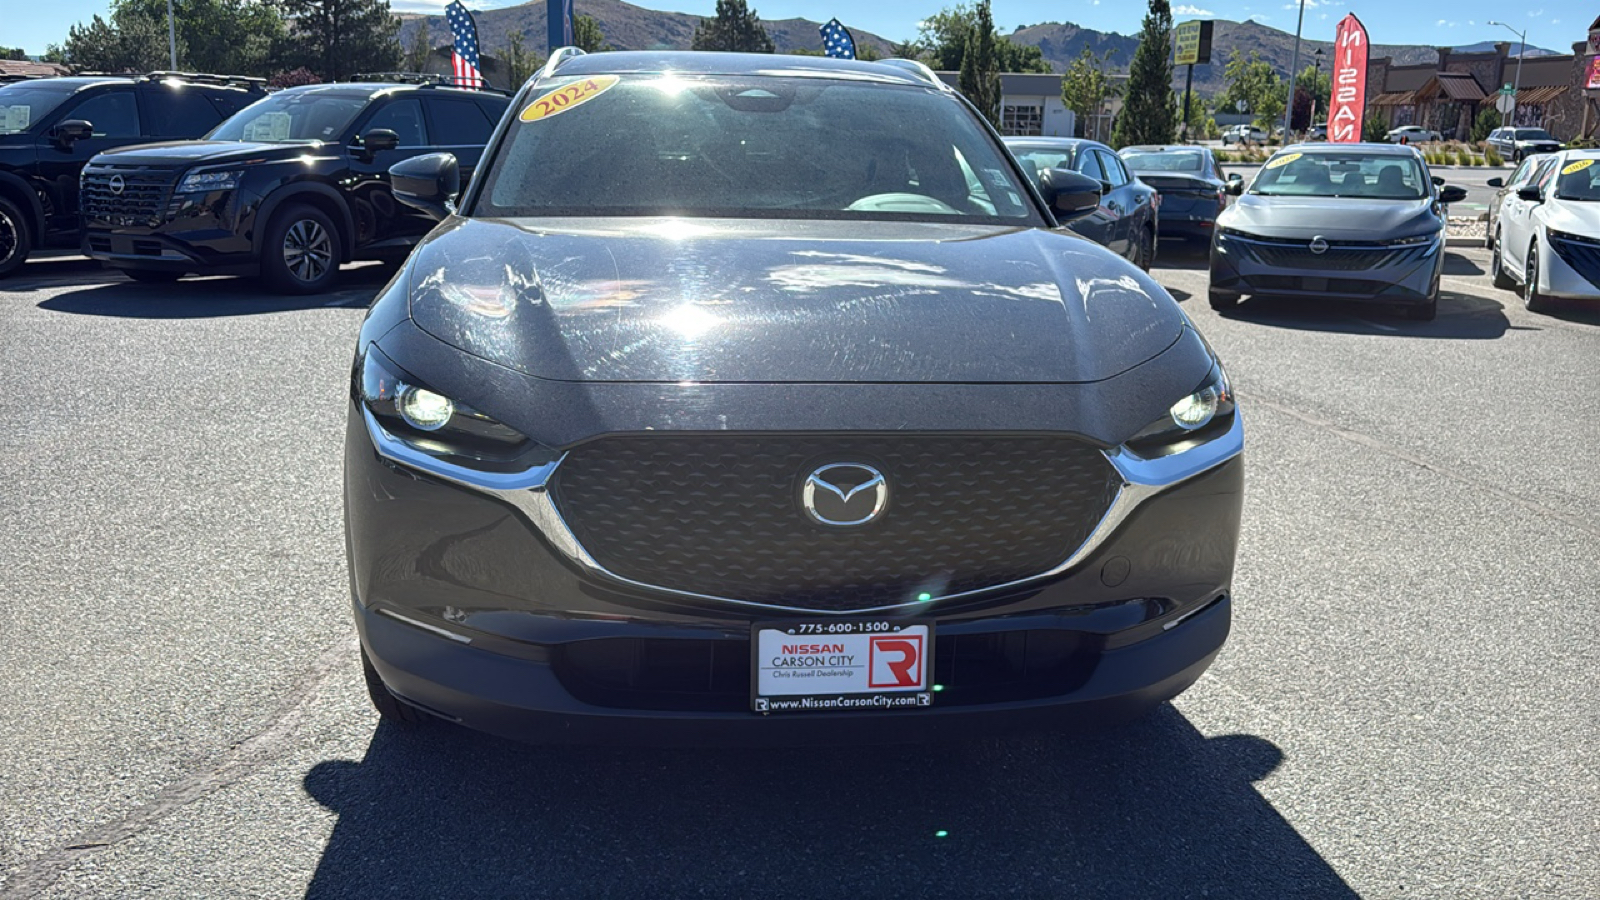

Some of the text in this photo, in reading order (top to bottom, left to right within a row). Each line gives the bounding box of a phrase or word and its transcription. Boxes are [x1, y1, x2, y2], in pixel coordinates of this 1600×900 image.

[535, 79, 599, 116] 2024
[799, 621, 890, 634] 775-600-1500
[782, 643, 845, 655] NISSAN
[772, 655, 854, 667] CARSON CITY
[772, 669, 854, 679] Chris Russell Dealership
[770, 695, 916, 709] www.NissanCarsonCity.com
